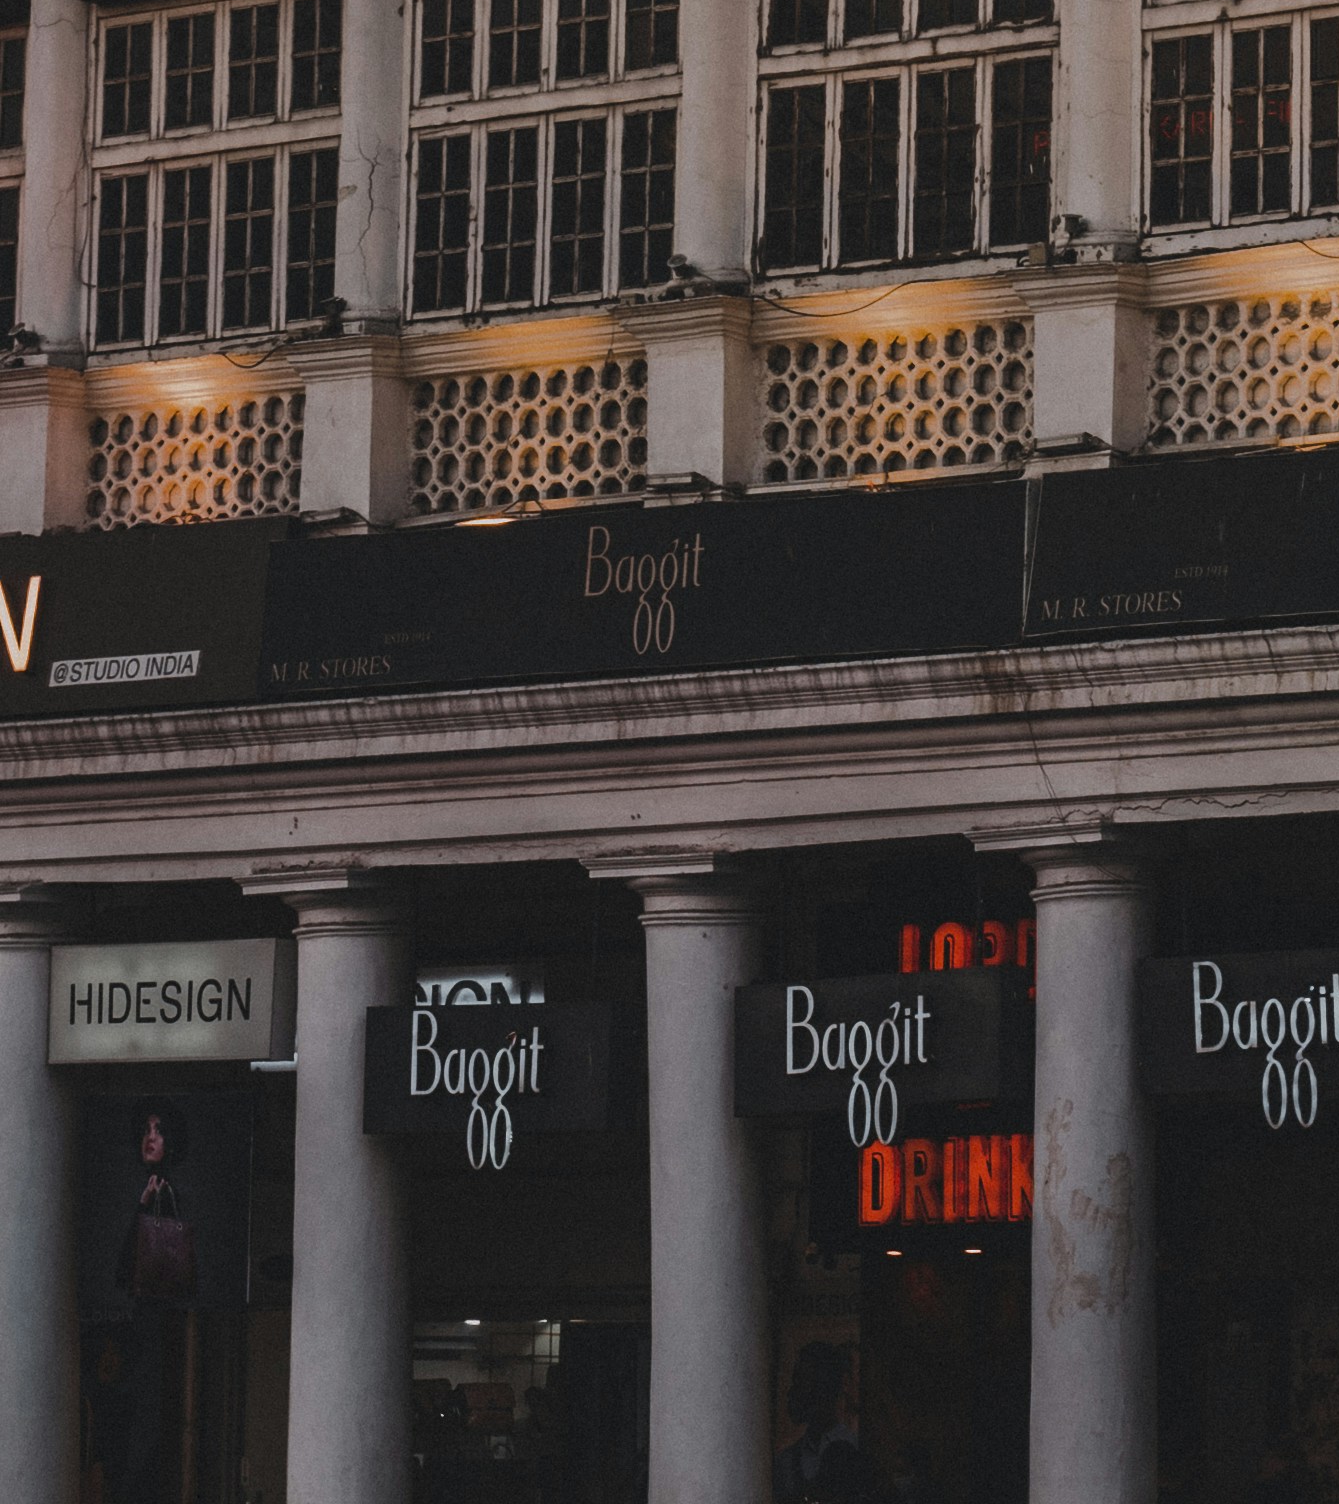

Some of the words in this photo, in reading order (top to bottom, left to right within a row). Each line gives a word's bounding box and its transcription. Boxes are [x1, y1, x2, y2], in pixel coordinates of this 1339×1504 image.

[583, 525, 706, 656] Baggit
[1097, 589, 1184, 617] STORES
[52, 657, 141, 685] @STUDIO
[144, 653, 194, 678] INDIA
[319, 654, 393, 679] STORES
[68, 977, 253, 1026] HIDESIGN
[410, 1008, 545, 1170] Baggit
[785, 984, 932, 1148] Baggit
